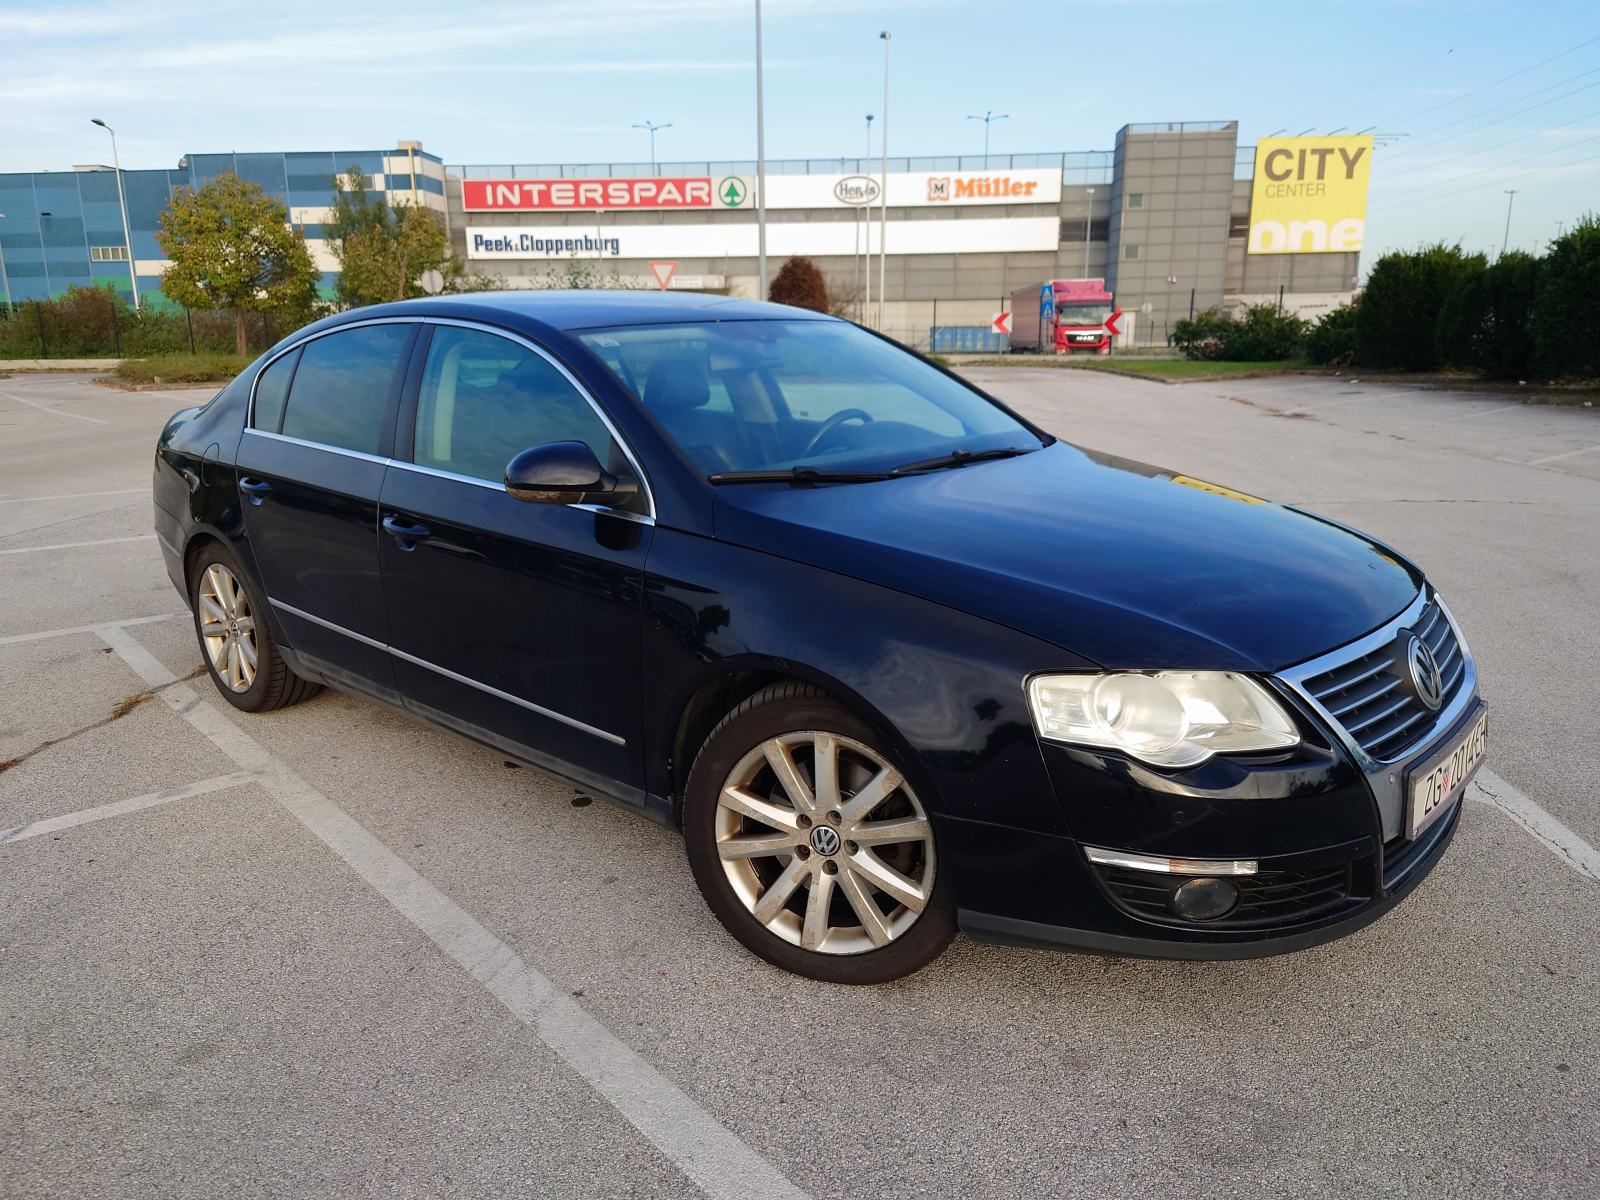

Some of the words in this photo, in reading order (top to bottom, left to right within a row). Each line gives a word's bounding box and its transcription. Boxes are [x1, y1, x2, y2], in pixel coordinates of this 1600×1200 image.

[1264, 147, 1367, 182] CITY
[485, 181, 711, 206] INTERSPAR
[954, 177, 1038, 198] Müller
[1265, 183, 1326, 198] CENTER
[1251, 218, 1365, 252] one
[1424, 766, 1442, 816] ZG
[811, 826, 840, 855] VW
